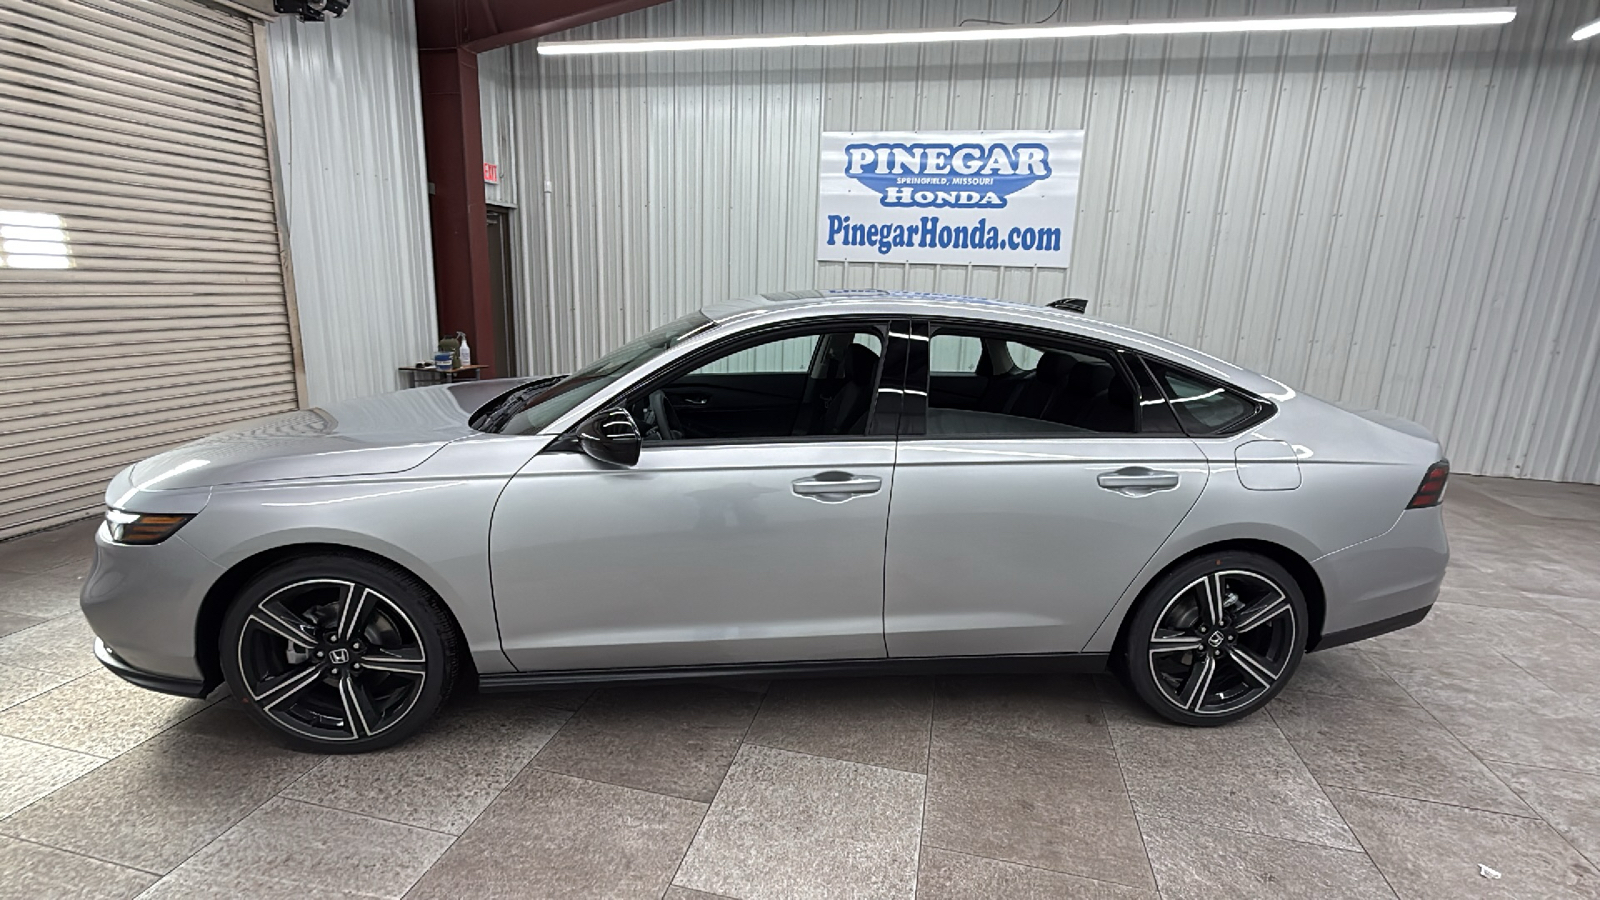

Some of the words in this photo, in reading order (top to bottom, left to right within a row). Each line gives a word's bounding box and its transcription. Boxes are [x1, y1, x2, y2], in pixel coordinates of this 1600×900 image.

[483, 163, 497, 182] EXIT
[848, 147, 1048, 176] PINEGAR
[896, 177, 950, 186] SPRINGFIELD,
[951, 177, 994, 186] MISSOURI
[827, 215, 1061, 254] PinegarHonda.com
